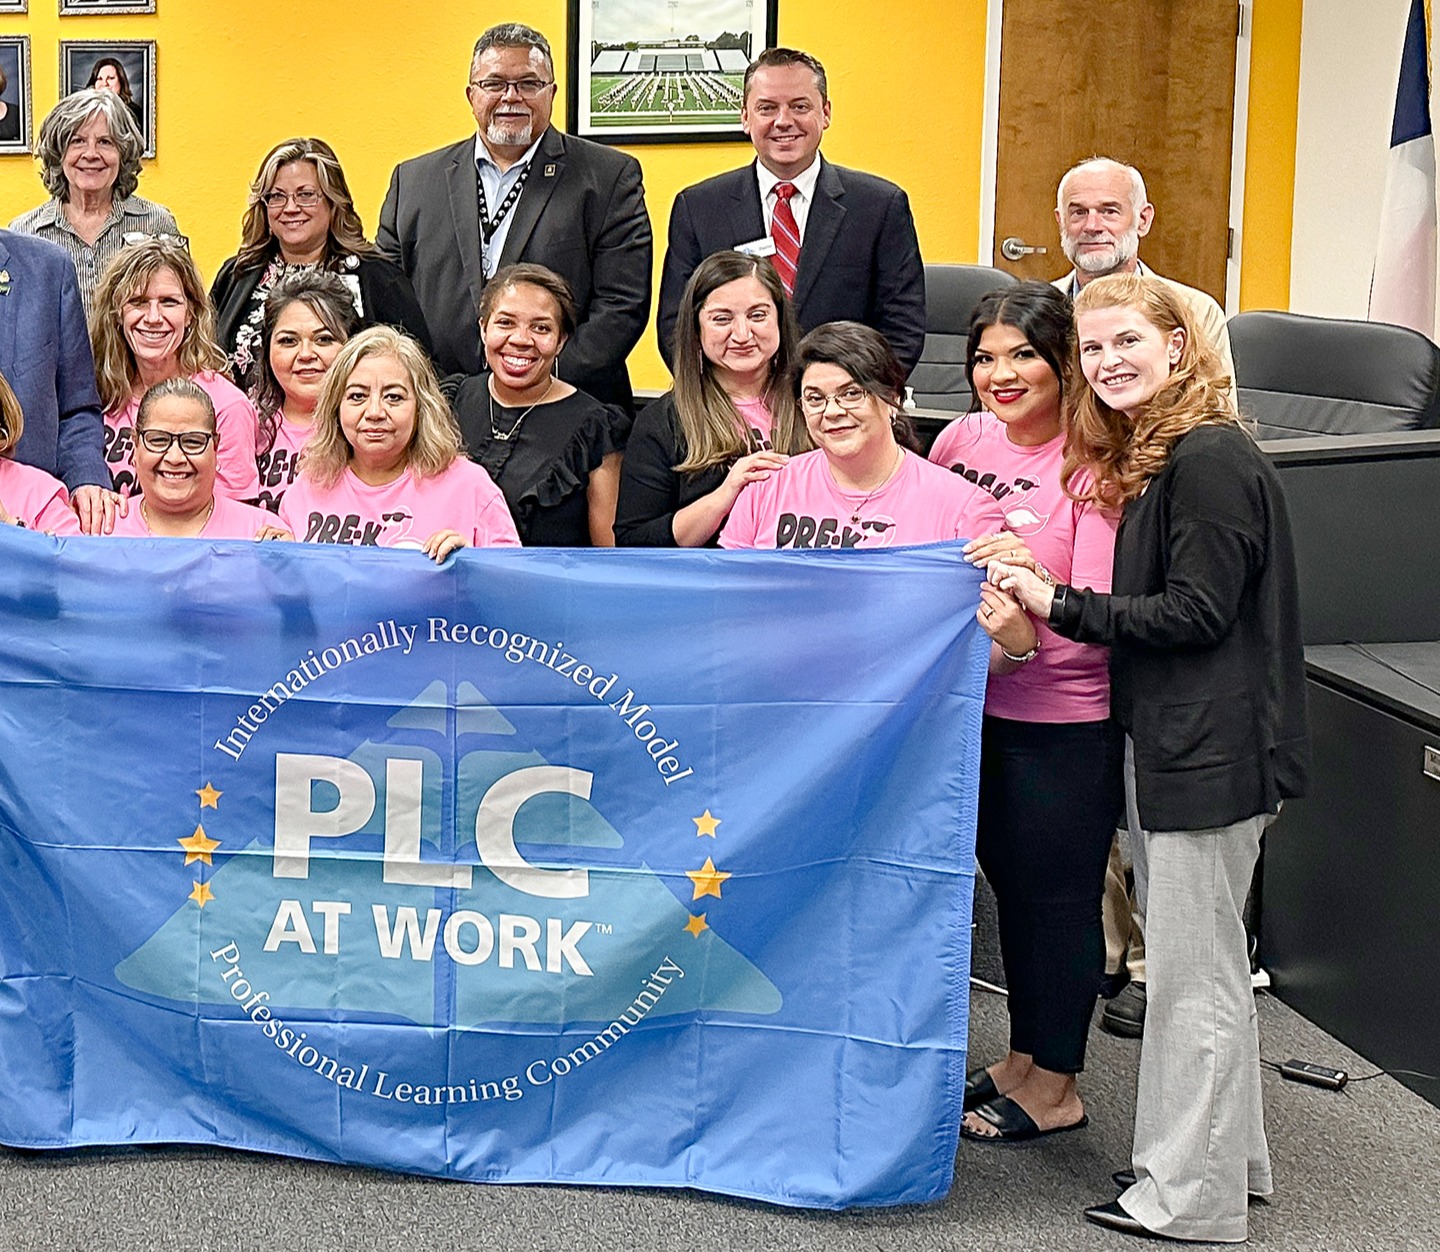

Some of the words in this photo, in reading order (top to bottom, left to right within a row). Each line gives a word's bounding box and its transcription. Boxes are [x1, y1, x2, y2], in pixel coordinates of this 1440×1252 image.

[303, 511, 383, 548] PRE-K
[776, 512, 863, 549] PRE-K
[214, 619, 418, 762] Internationally
[427, 617, 619, 701] Recognized
[609, 688, 694, 787] Model
[273, 752, 594, 899] PLC
[263, 900, 352, 955] AT
[371, 904, 595, 977] WORK
[210, 940, 369, 1092] Professional
[372, 1071, 524, 1106] Learning
[525, 955, 686, 1086] Community
